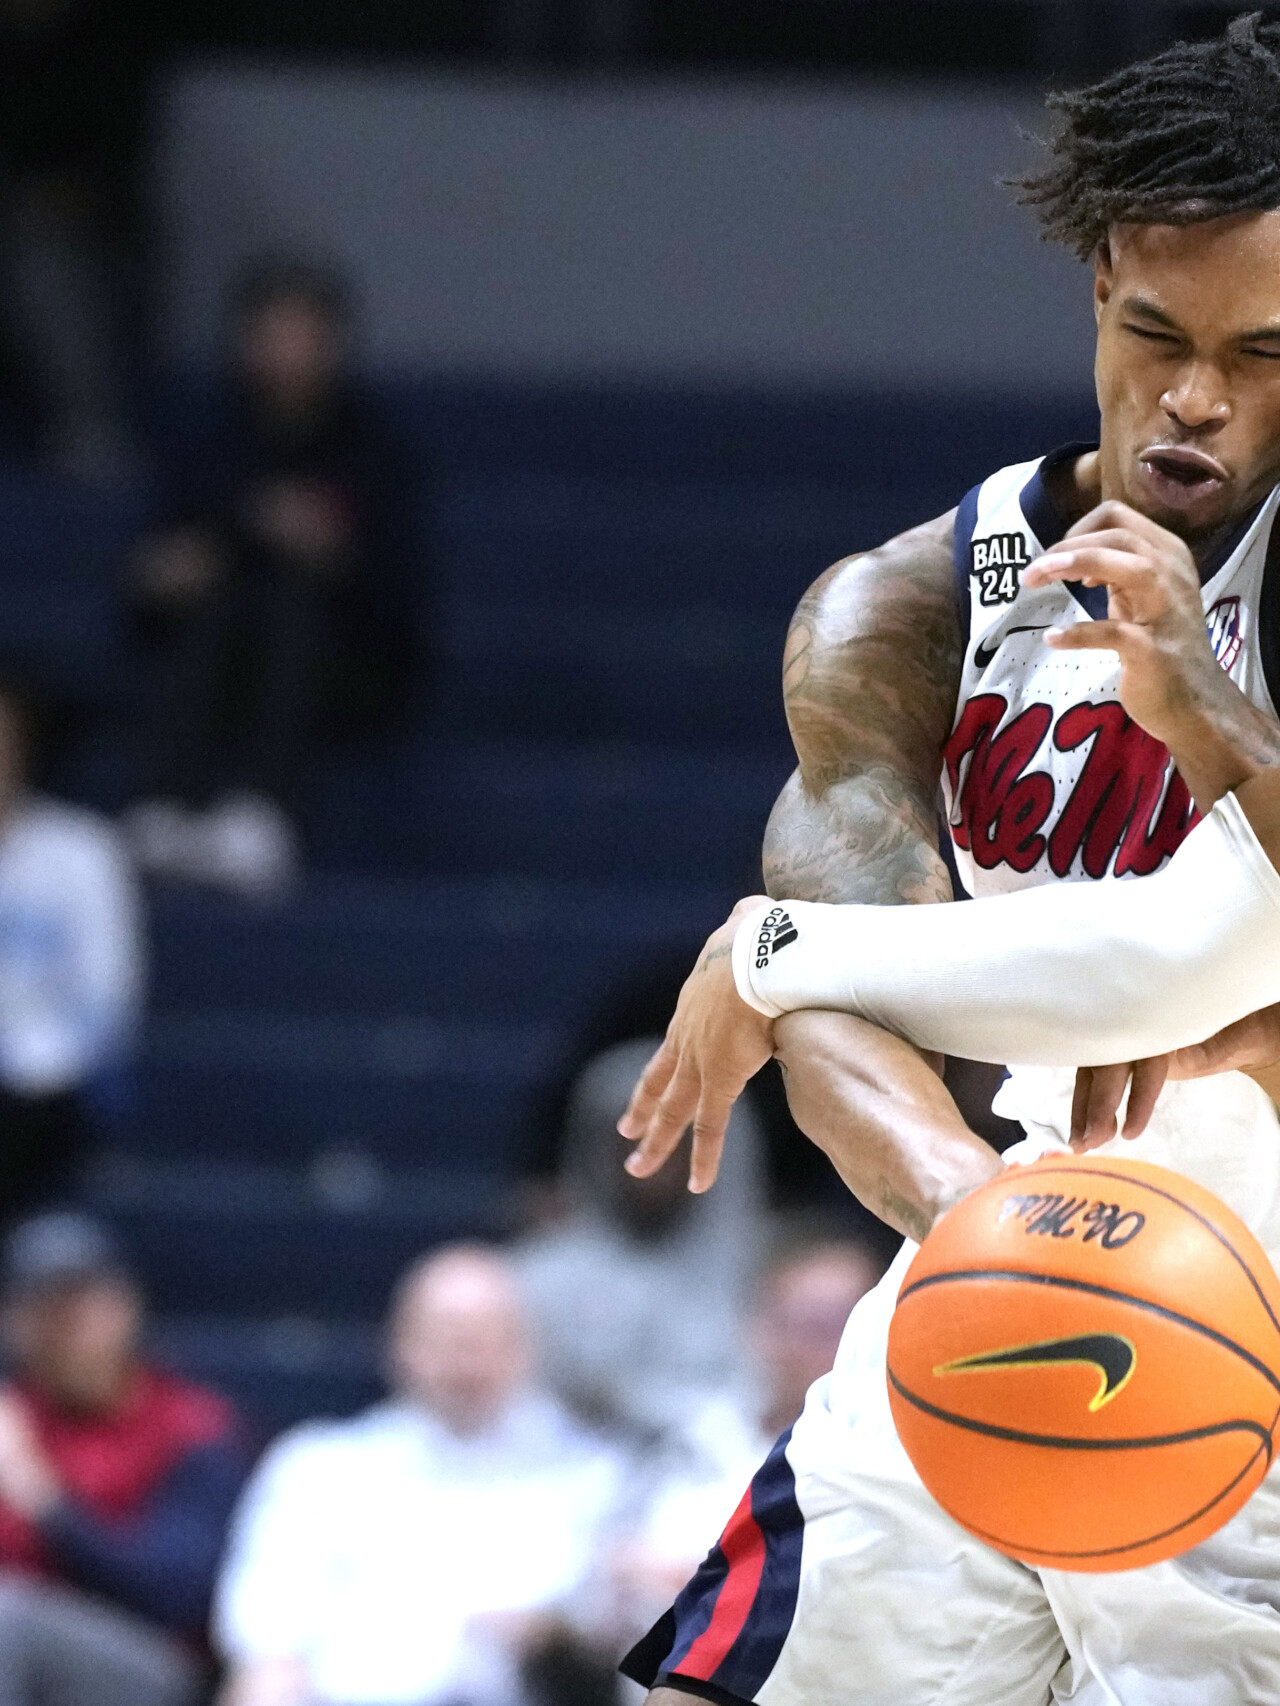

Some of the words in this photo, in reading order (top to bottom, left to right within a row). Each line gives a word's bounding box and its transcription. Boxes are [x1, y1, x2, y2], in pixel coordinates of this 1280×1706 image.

[973, 536, 1027, 571] BALL
[982, 566, 1016, 602] 24
[755, 907, 784, 969] adidas
[1082, 1201, 1146, 1250] Ole
